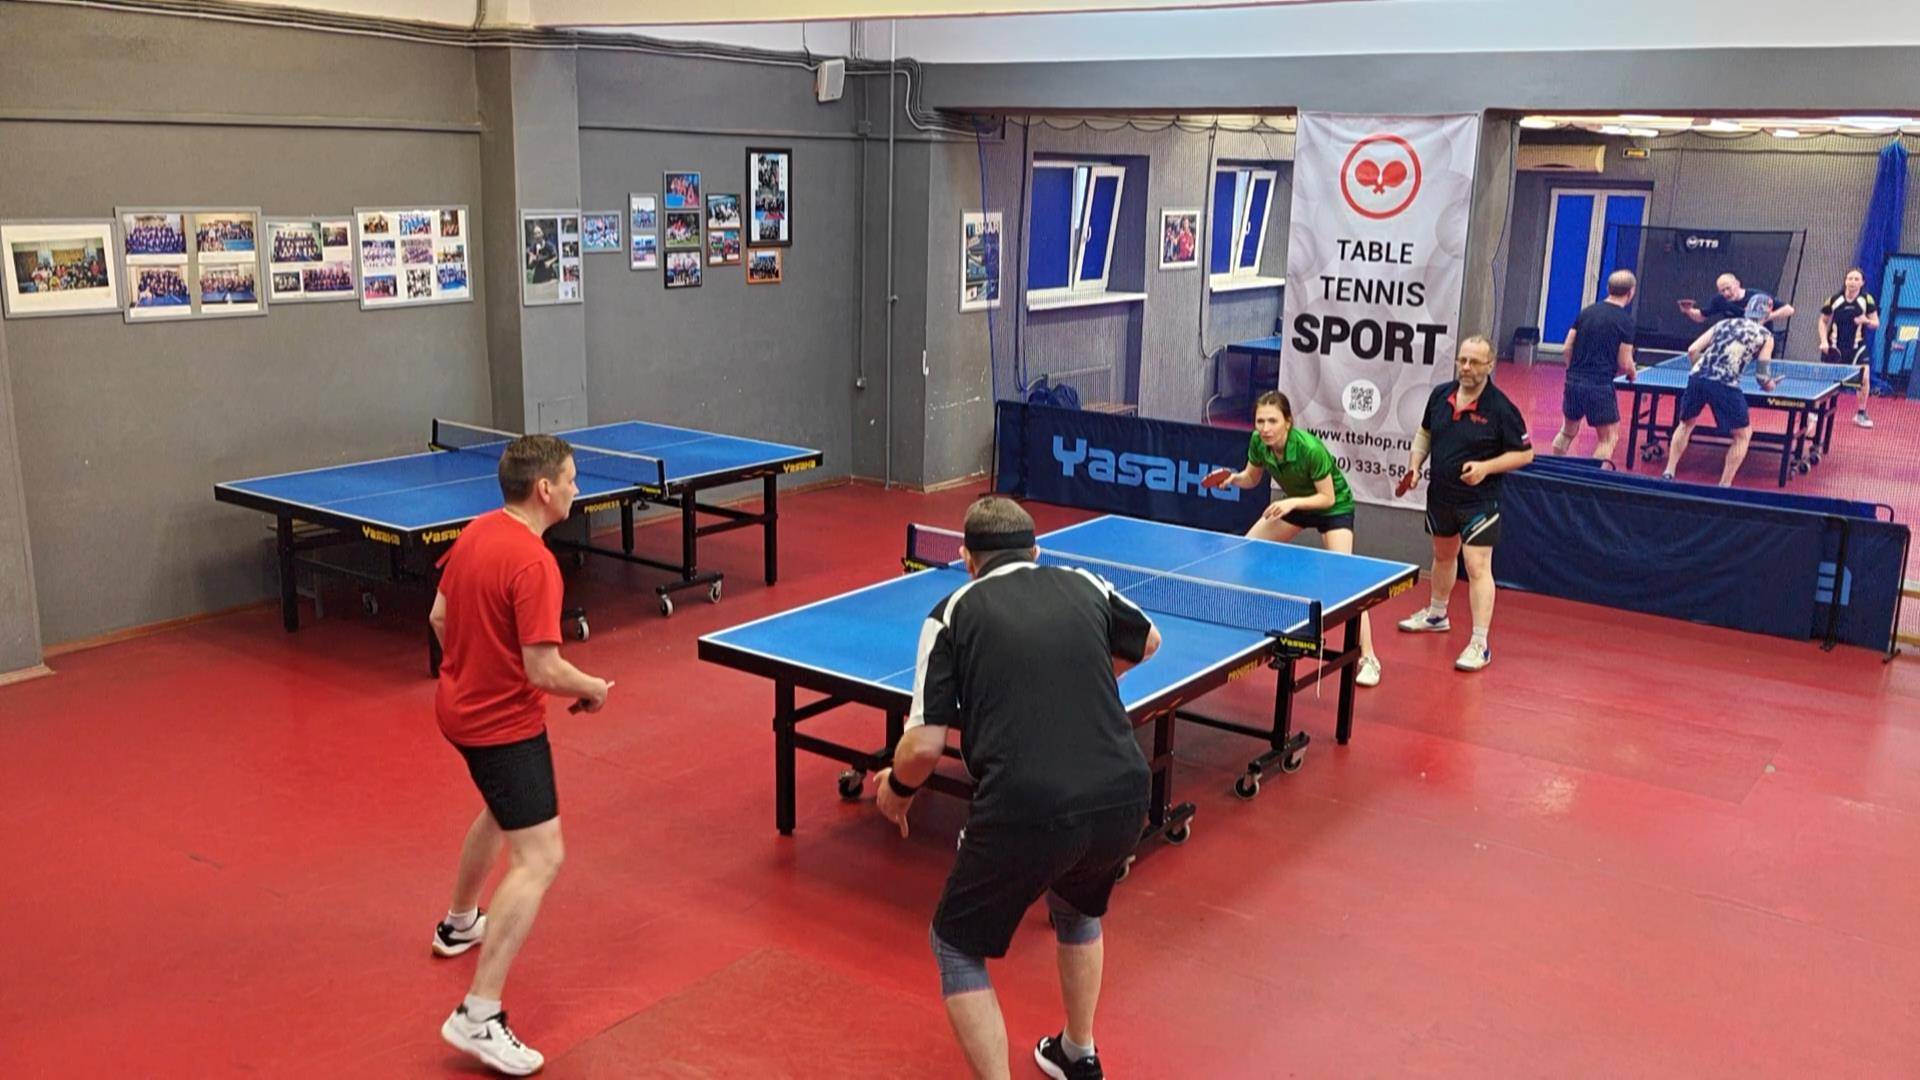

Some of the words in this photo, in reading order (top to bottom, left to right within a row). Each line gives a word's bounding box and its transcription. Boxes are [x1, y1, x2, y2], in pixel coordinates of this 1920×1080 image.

[1337, 239, 1414, 264] TABLE
[1320, 275, 1426, 307] TENNIS
[1291, 313, 1448, 365] SPORT
[1307, 427, 1412, 451] www.ttshop.ru
[422, 528, 461, 545] Yasa
[1280, 637, 1317, 651] Yasaka
